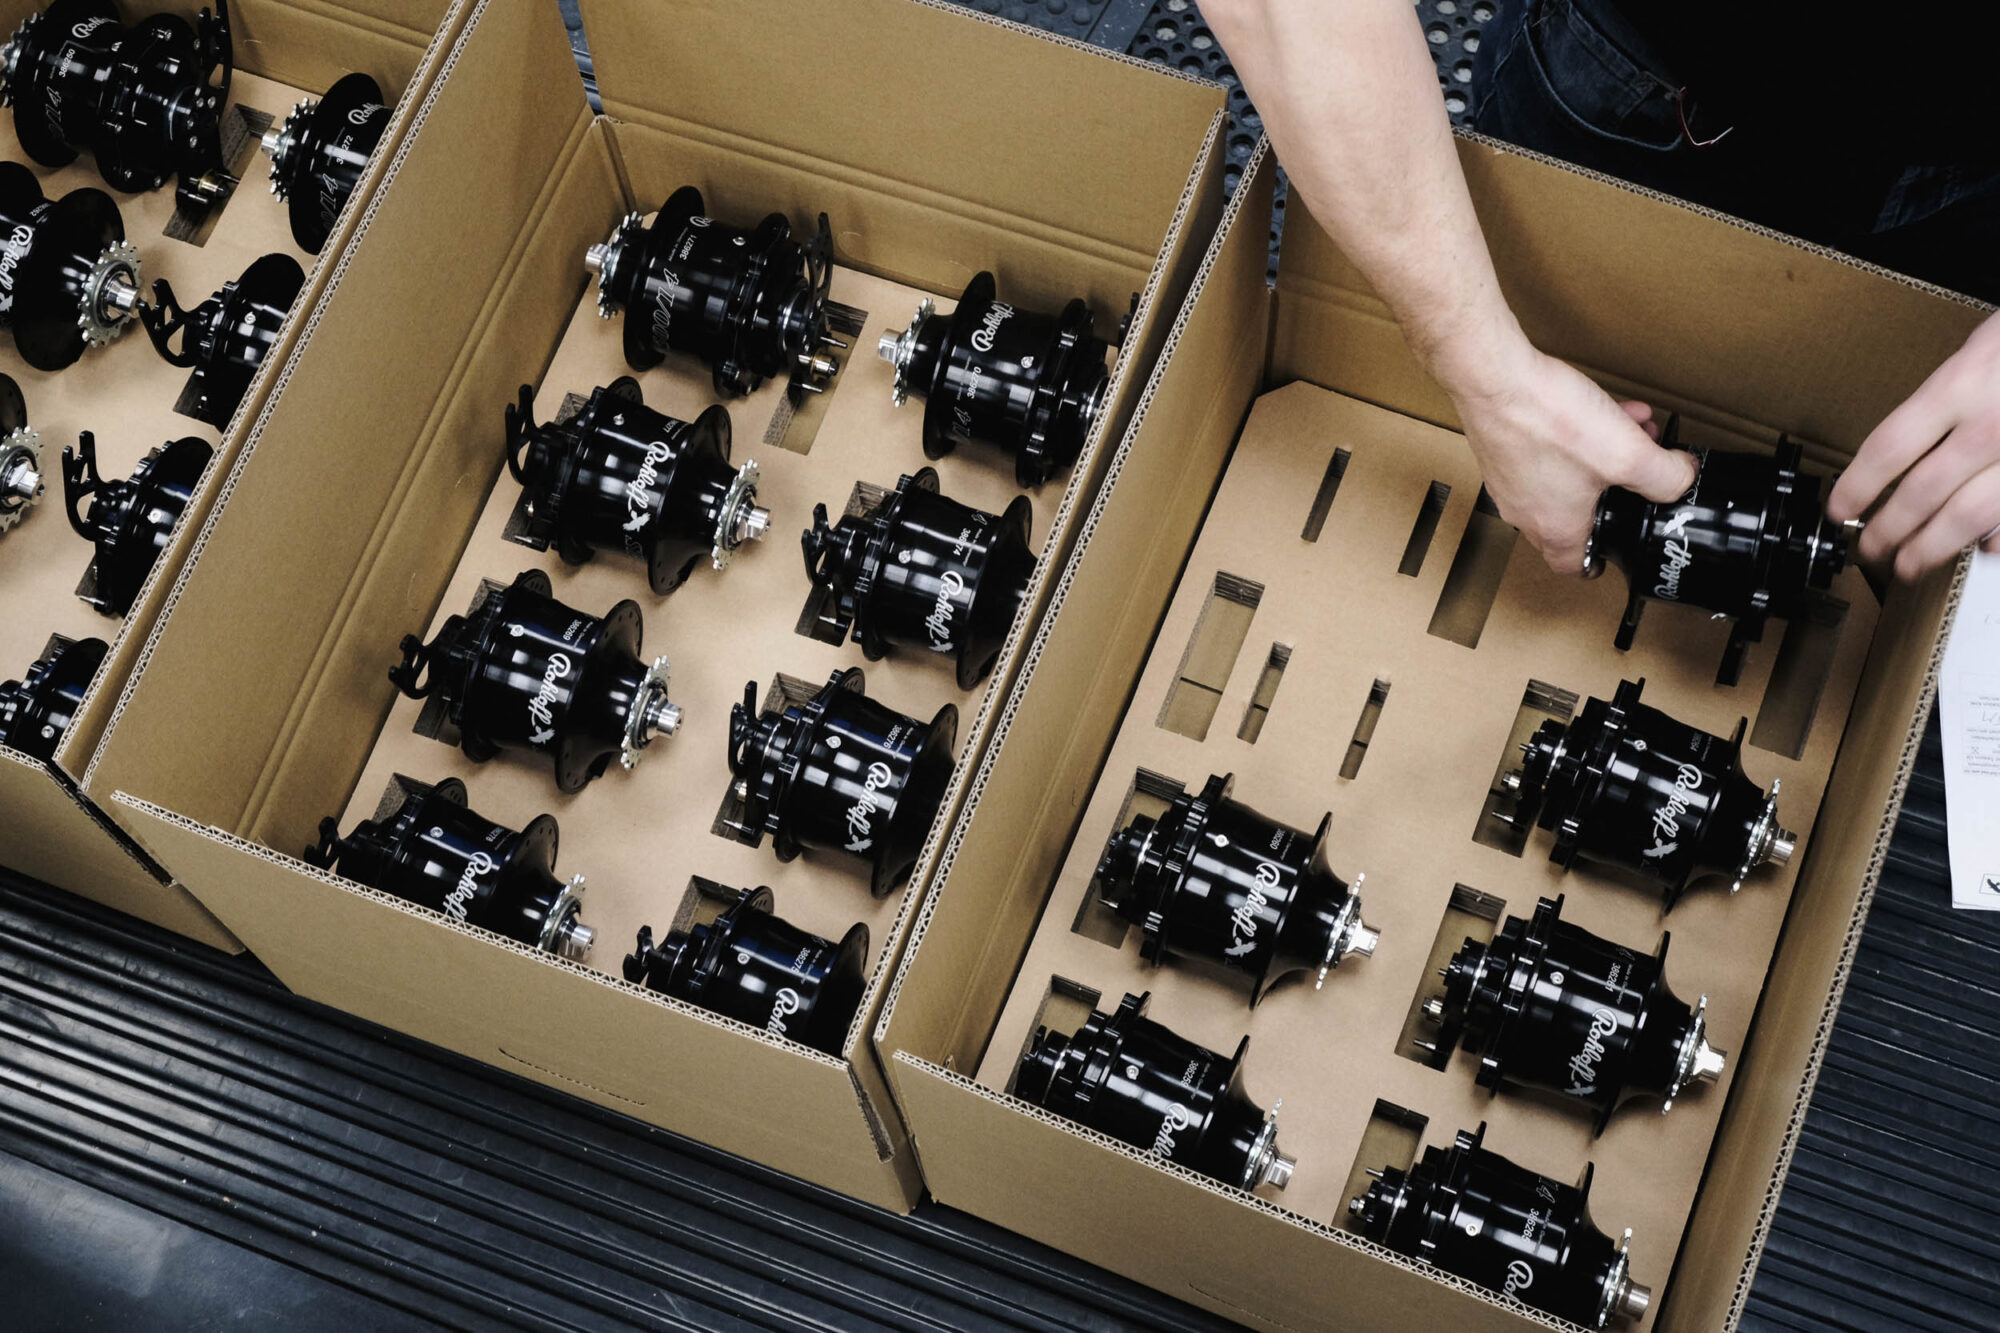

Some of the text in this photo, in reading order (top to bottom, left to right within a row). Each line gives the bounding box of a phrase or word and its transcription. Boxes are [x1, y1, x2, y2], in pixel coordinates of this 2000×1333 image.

[335, 135, 355, 164] 3272
[971, 301, 1015, 352] Rohloff
[625, 441, 670, 510] Rohloff
[952, 528, 970, 555] 38674
[1654, 539, 1692, 600] Rohloff
[925, 570, 964, 640] Rohloff
[528, 652, 571, 726] Rohloff
[846, 761, 892, 836] Rohloff
[1652, 763, 1702, 839] Rohloff
[442, 851, 492, 922] Rohloff
[1231, 862, 1281, 938] Rohloff
[1569, 1007, 1618, 1083] Rohloff
[1149, 1102, 1189, 1158] Rohlo
